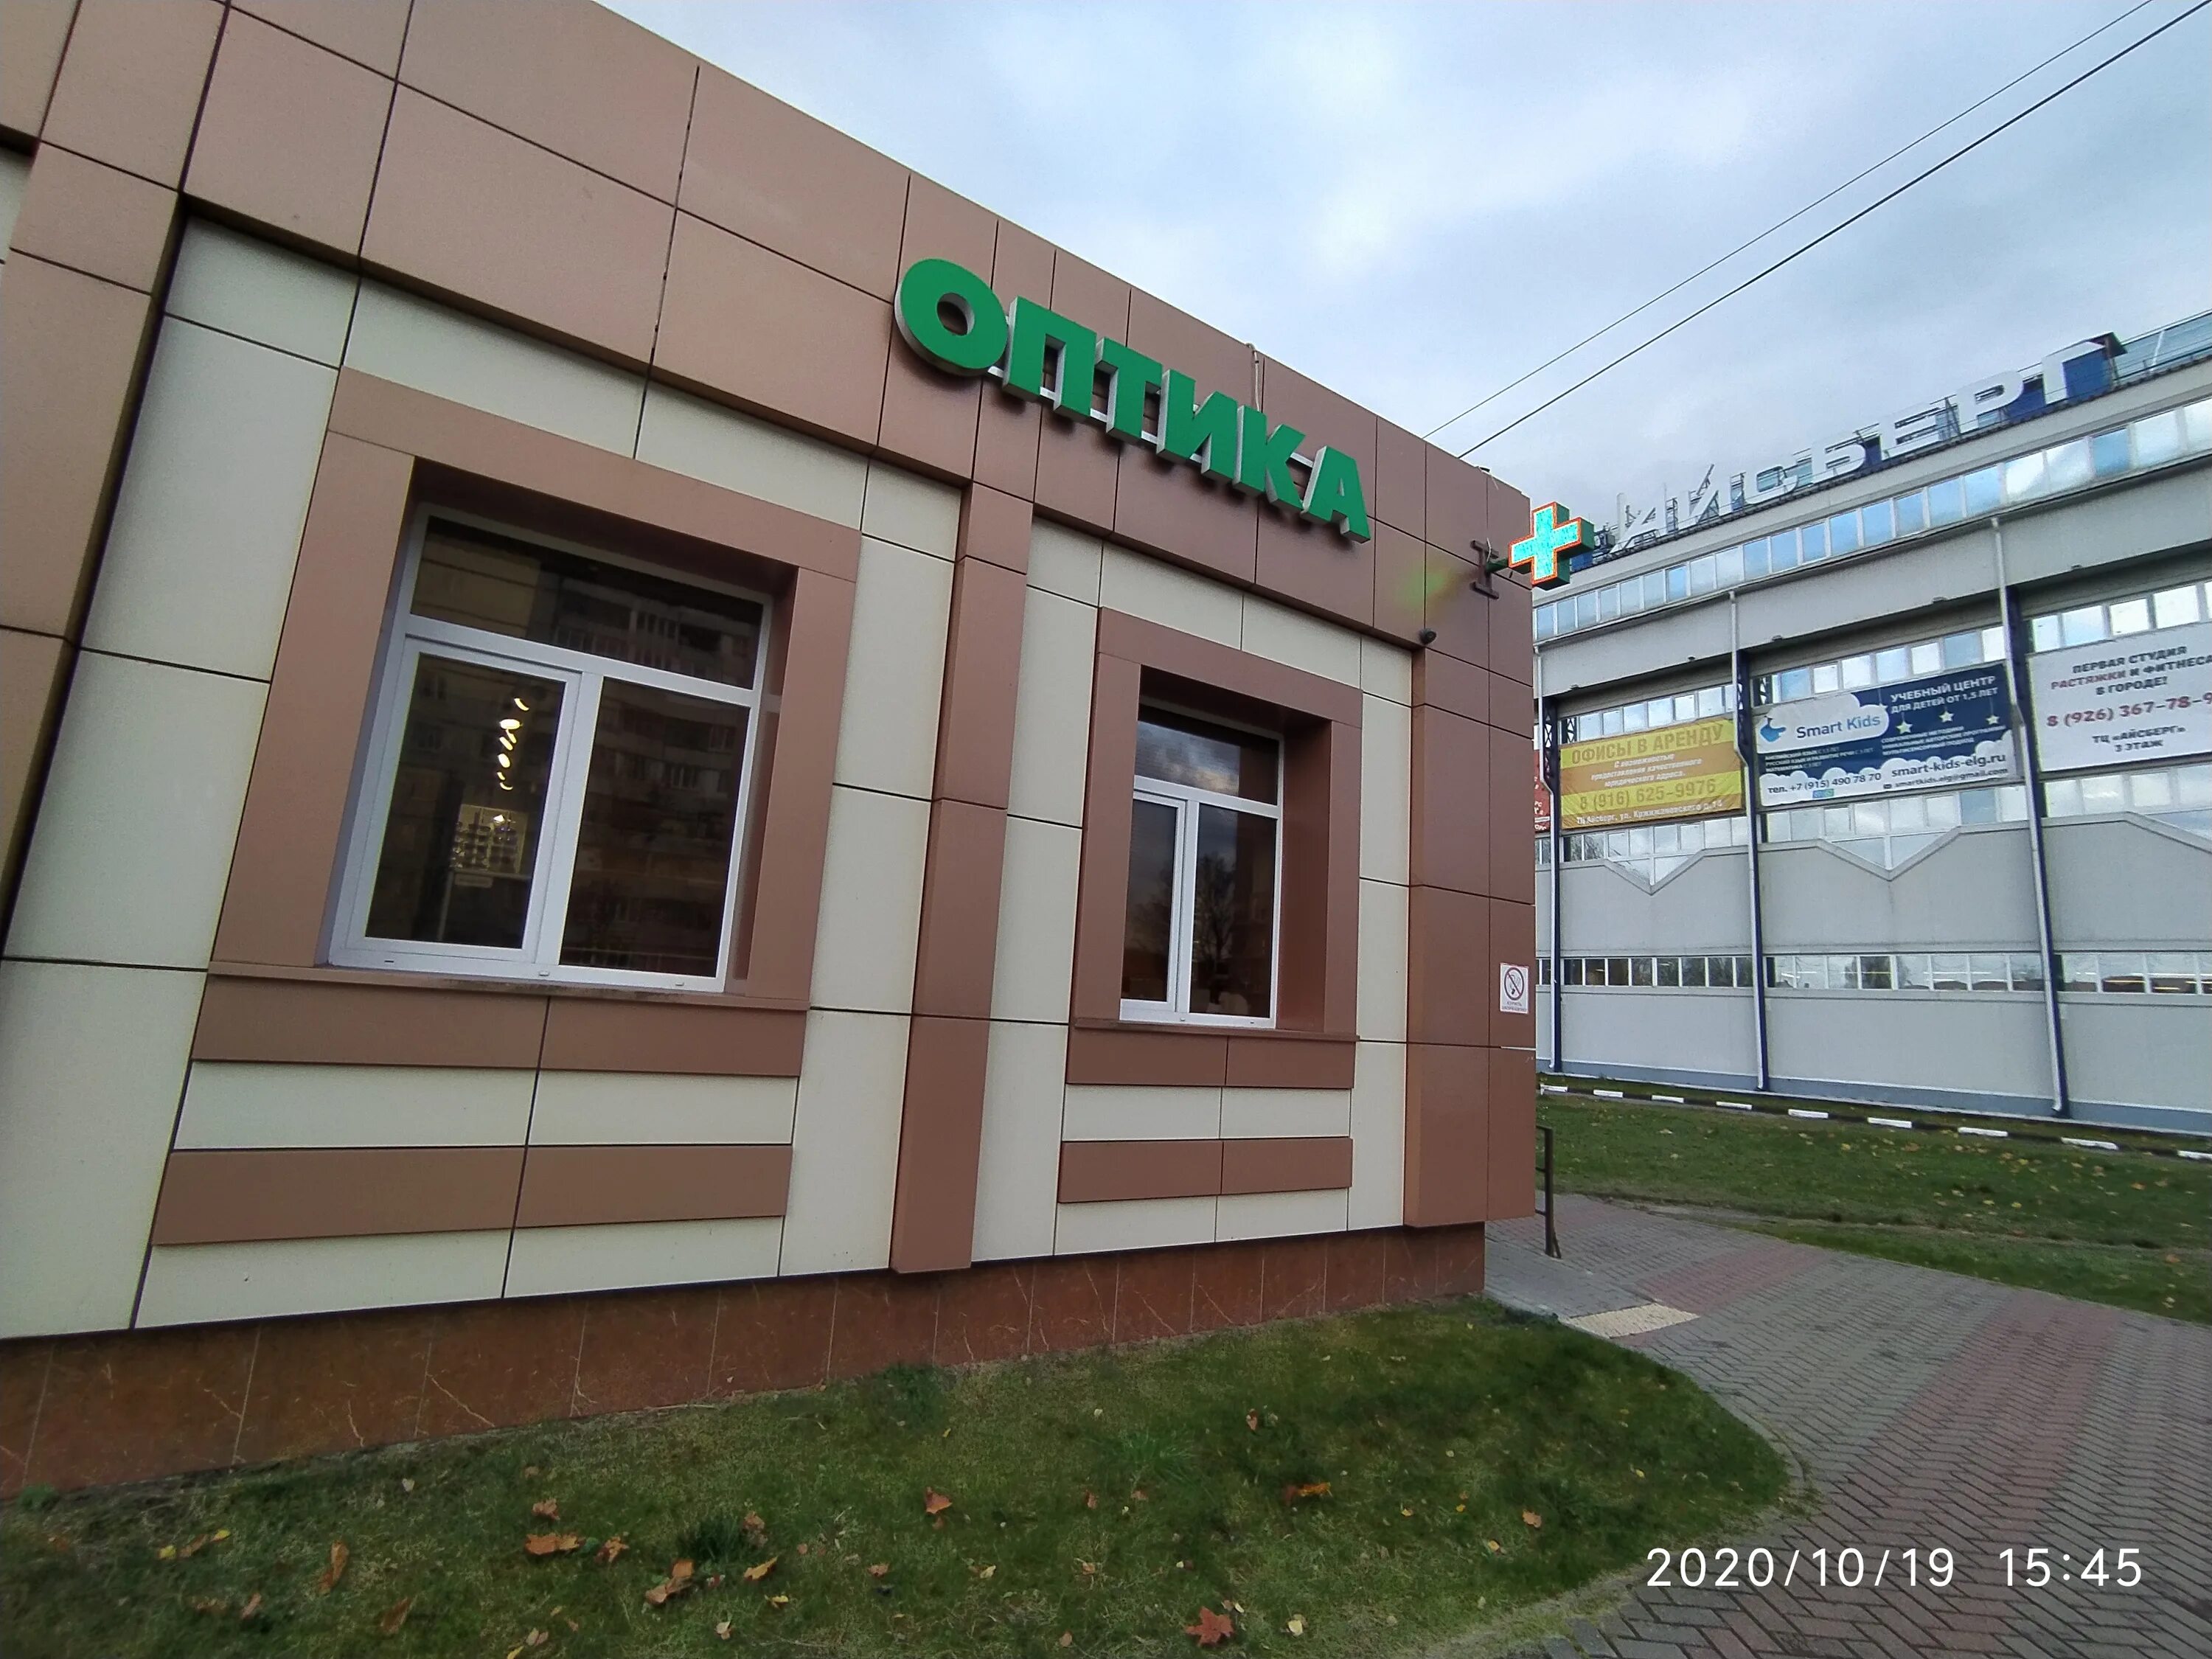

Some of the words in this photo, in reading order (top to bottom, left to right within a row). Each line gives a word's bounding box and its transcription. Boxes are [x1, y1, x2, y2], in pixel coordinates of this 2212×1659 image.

[894, 258, 1371, 544] ОПТИКА
[2073, 657, 2125, 674] ПЕРВАЯ
[2128, 646, 2187, 664] СТУДИЯ
[1891, 683, 1951, 702] УЧЕБНЫЙ
[1953, 675, 1996, 691] ЦЕНТР
[2051, 669, 2126, 689] РАСТЯЖКИ
[2129, 668, 2140, 676] И
[2096, 686, 2105, 695] В
[1891, 703, 1911, 714] ДЛЯ
[1913, 697, 1945, 711] ДЕТЕЙ
[1946, 695, 1960, 703] ОТ
[1978, 687, 1998, 698] ЛЕТ
[1796, 718, 1842, 739] Smart
[1847, 713, 1881, 732] Kids
[2046, 715, 2059, 727] 8
[2064, 707, 2115, 727] (926)
[1572, 740, 1632, 764] ОФИСЫ
[1638, 737, 1648, 753] В
[1653, 723, 1724, 751] АРЕНДУ
[2092, 734, 2110, 743] ТЦ
[2115, 744, 2122, 753] 3
[2125, 740, 2164, 751] ЭТАЖ
[1891, 754, 2006, 777] smart-kids-elg.ru
[1580, 796, 1587, 810] 8
[1593, 790, 1630, 811] (916)
[1637, 779, 1716, 802] 625-9976
[1767, 785, 1788, 794] тел.
[1790, 783, 1802, 791] +7
[1804, 779, 1829, 790] (915)
[1832, 776, 1851, 785] 490
[1853, 774, 1865, 783] 78
[1868, 772, 1881, 782] 70
